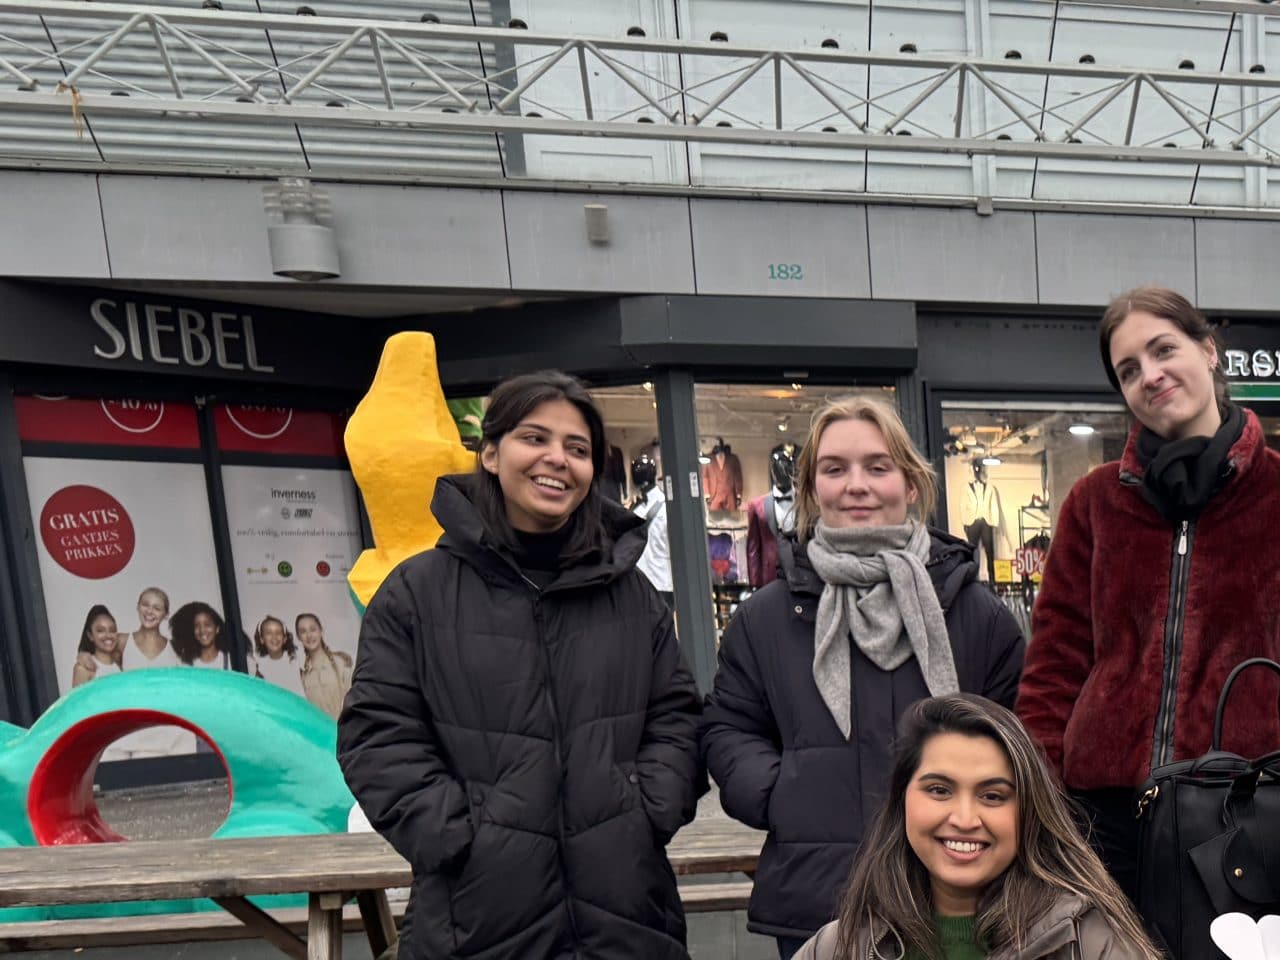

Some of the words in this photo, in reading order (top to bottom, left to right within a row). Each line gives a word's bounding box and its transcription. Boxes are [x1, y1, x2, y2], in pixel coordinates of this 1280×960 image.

[767, 263, 803, 281] 182
[90, 298, 275, 374] SIEBEL
[49, 507, 120, 531] GRATIS
[60, 530, 120, 547] GAATJES
[64, 543, 123, 561] PRIKKEN
[1012, 548, 1044, 574] -50%
